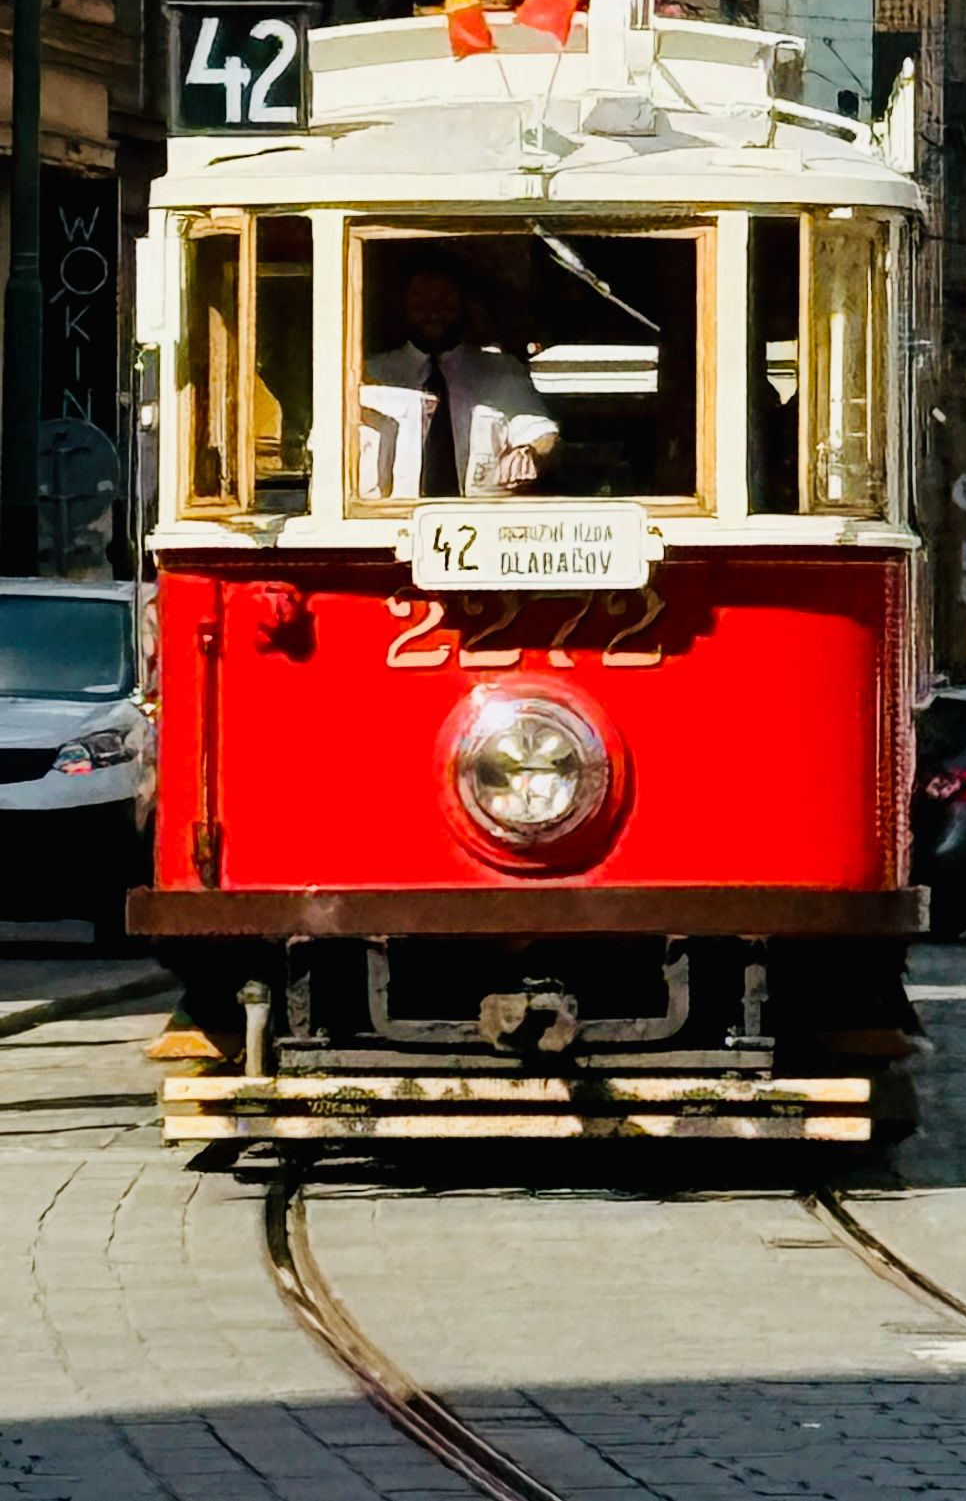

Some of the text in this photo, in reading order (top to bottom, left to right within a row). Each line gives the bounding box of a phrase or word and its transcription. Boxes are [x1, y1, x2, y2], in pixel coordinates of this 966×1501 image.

[185, 17, 298, 123] 42
[432, 523, 479, 571] 42
[384, 586, 667, 669] 2272
